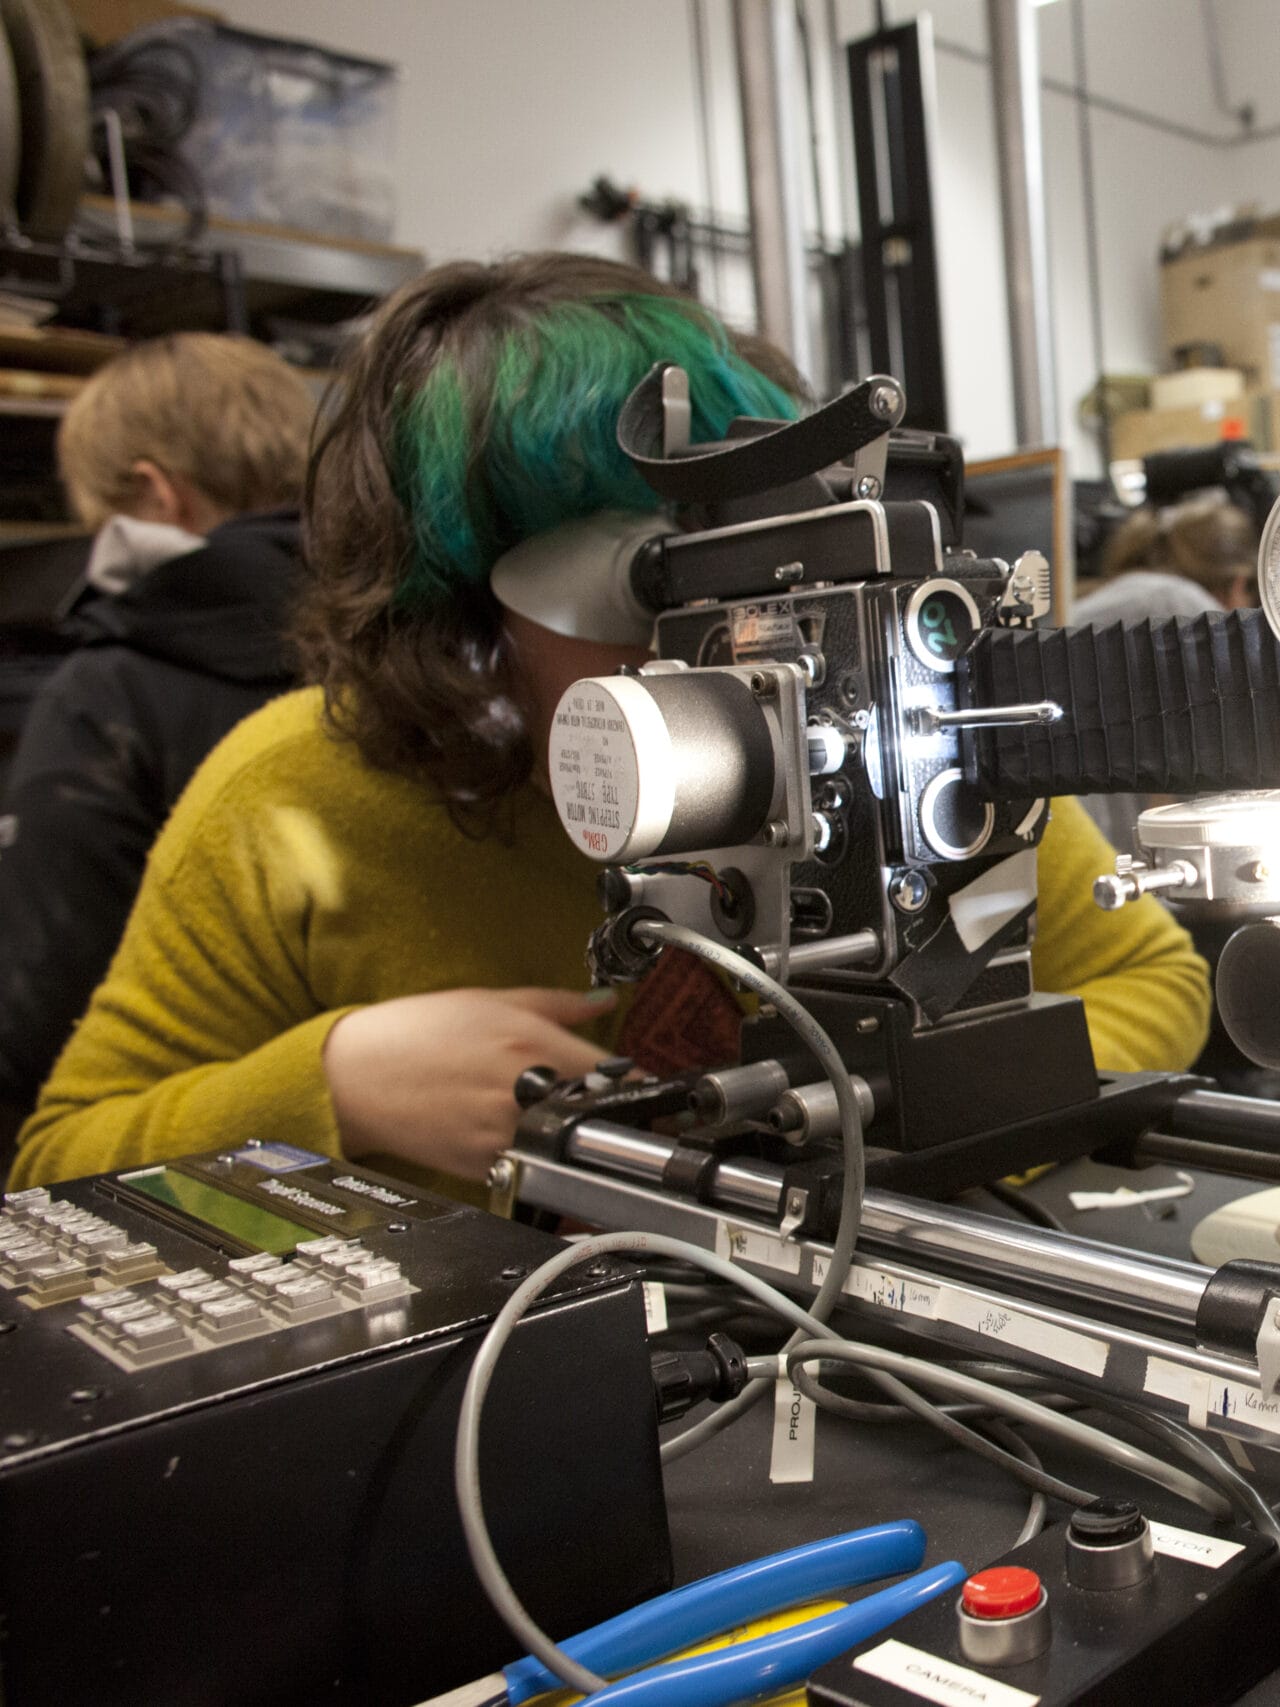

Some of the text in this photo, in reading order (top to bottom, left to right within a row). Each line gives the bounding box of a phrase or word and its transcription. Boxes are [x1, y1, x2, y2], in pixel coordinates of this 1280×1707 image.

[602, 784, 619, 805] TYPE
[566, 802, 620, 829] STEPPING MOTOR
[789, 1384, 802, 1441] PROJ
[1156, 1534, 1213, 1556] CTOR
[905, 1663, 988, 1703] CAMERA
